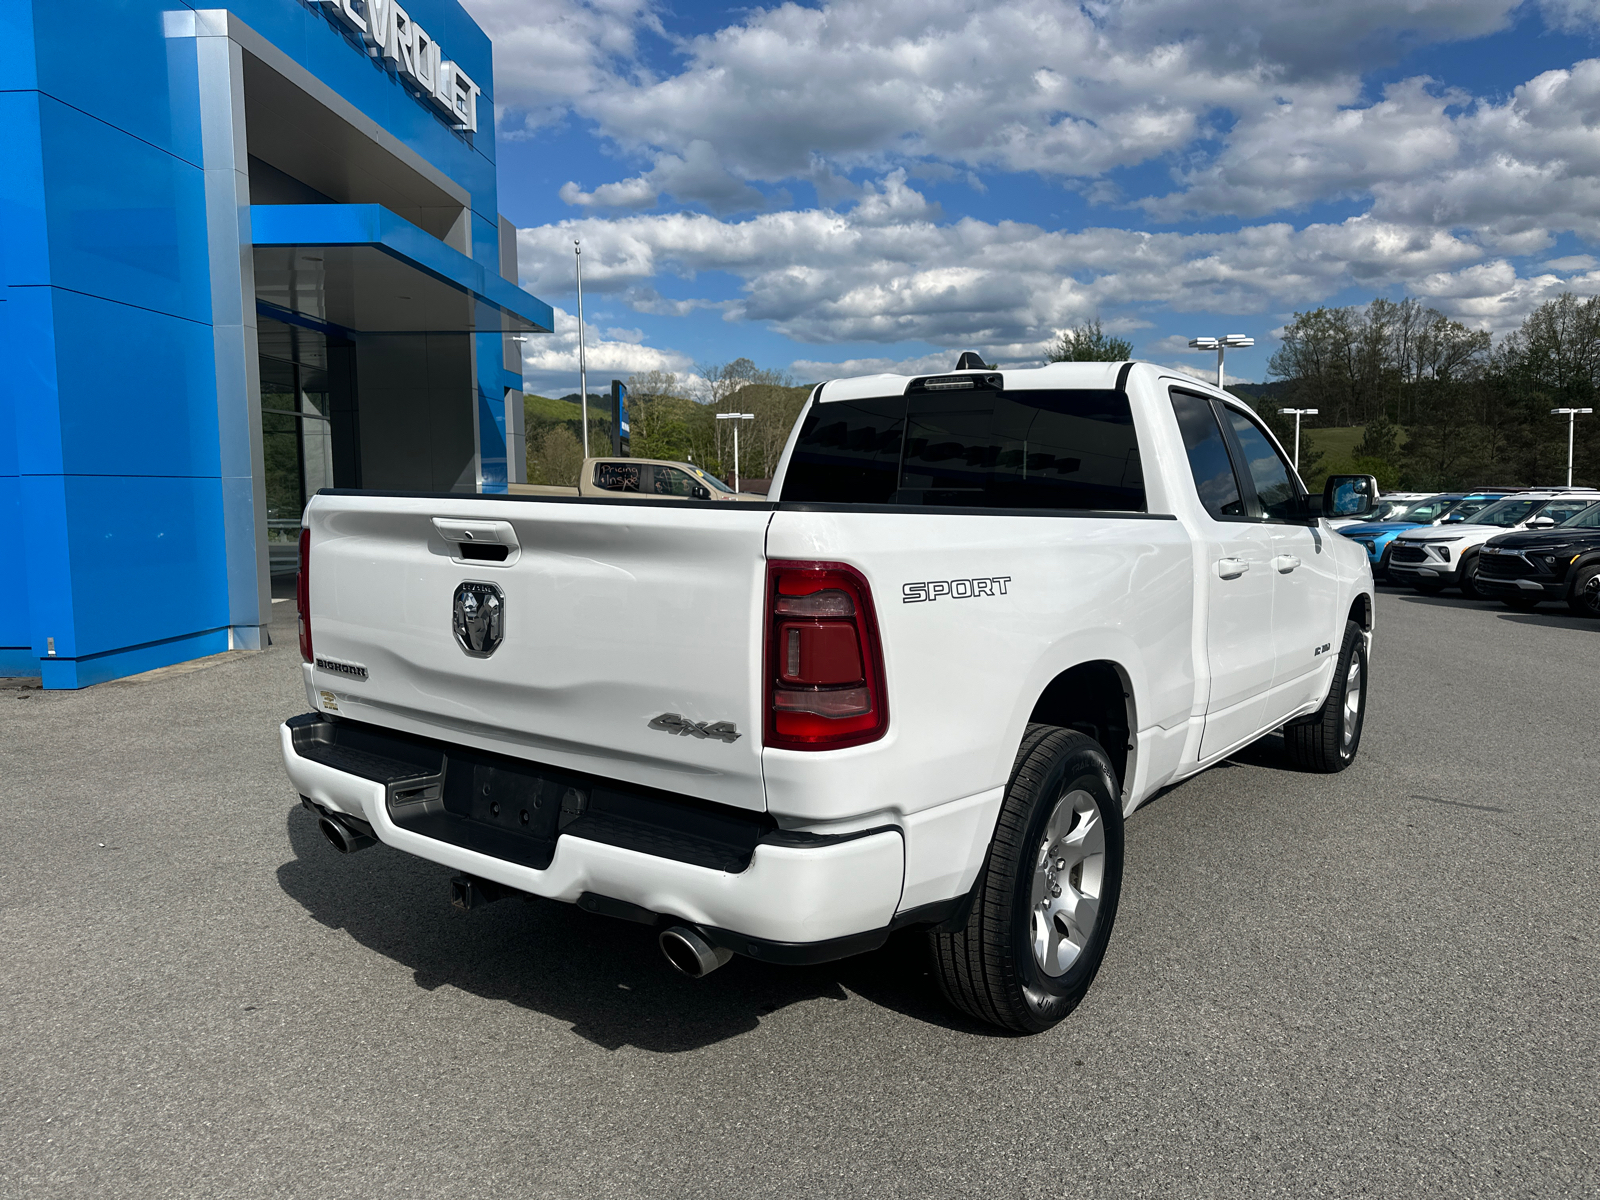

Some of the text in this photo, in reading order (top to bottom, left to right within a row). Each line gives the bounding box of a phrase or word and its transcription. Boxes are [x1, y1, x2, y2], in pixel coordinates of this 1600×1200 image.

[308, 0, 481, 133] VROLET
[601, 465, 639, 478] Pricing
[606, 474, 639, 486] Inside
[902, 576, 1012, 604] SPORT
[315, 658, 368, 679] BIGHORN
[1037, 996, 1078, 1016] SUMMIT
